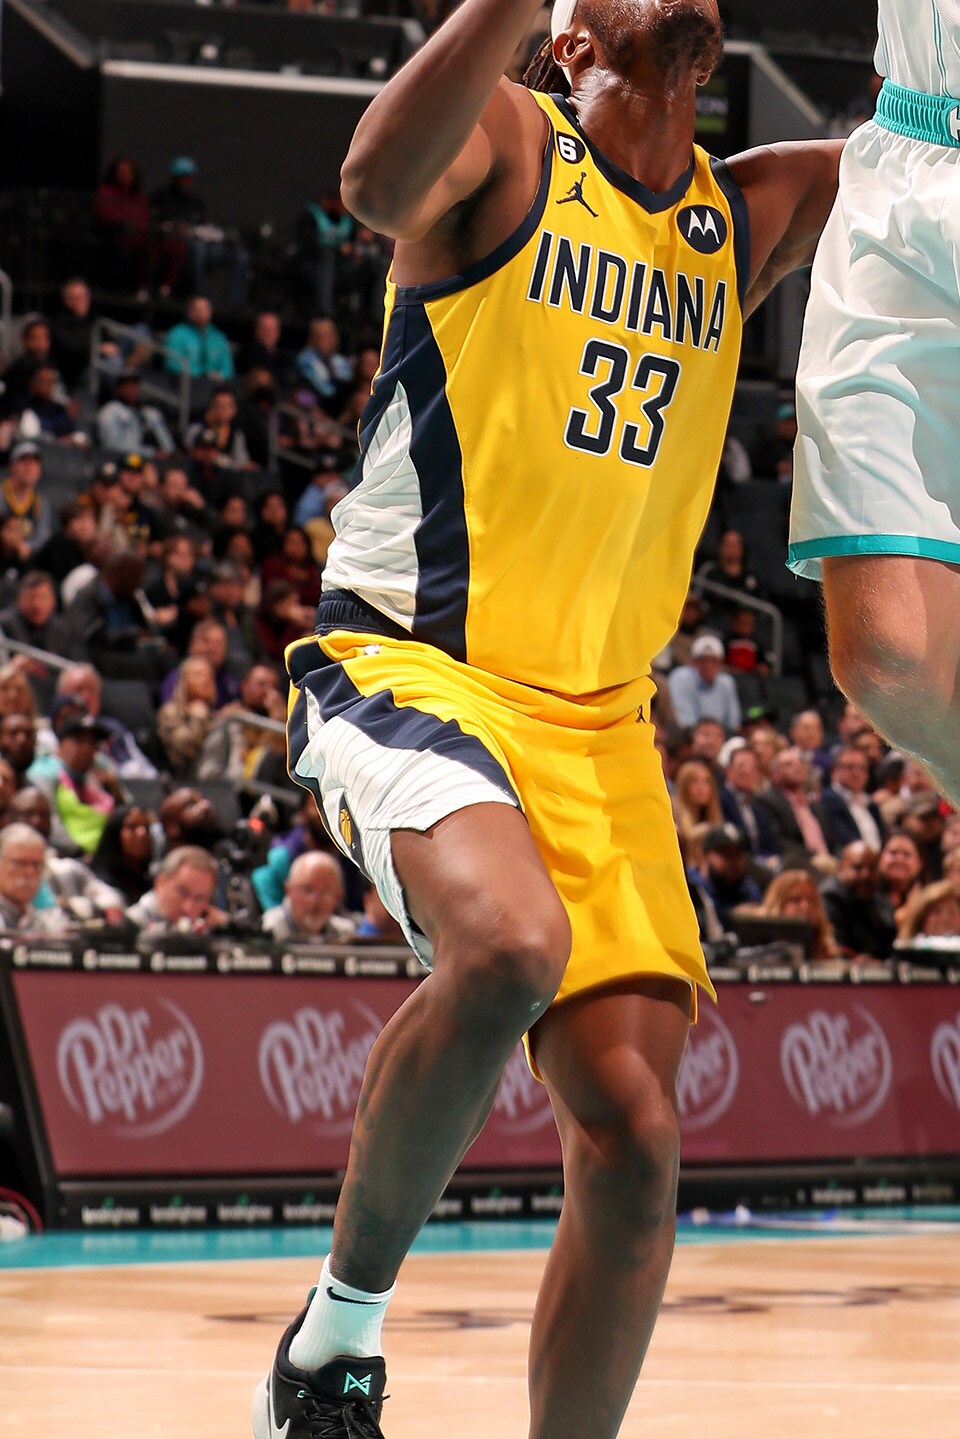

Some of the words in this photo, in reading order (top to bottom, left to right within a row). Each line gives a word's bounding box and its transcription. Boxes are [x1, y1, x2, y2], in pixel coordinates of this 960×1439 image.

[557, 135, 578, 161] 6
[526, 229, 727, 355] INDIANA
[564, 338, 681, 469] 33
[56, 1018, 187, 1124] Pepper
[97, 1003, 150, 1062] Dr
